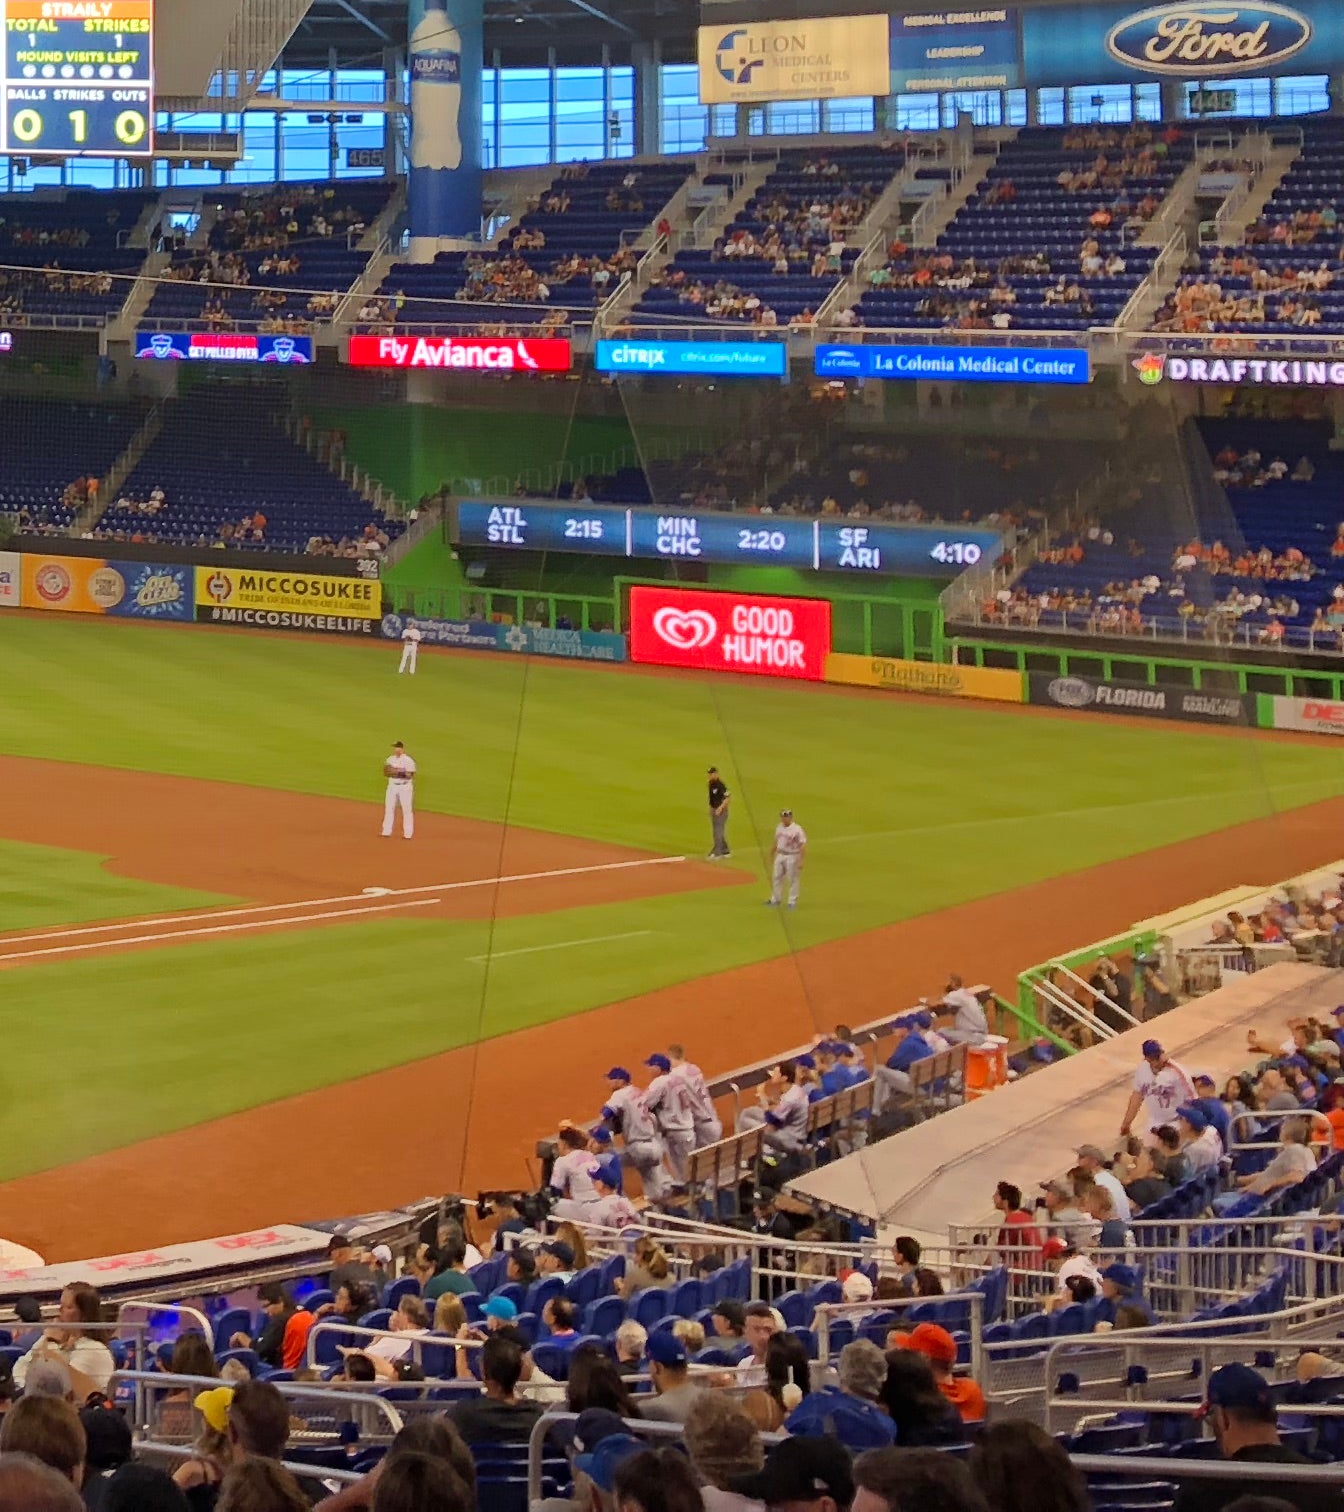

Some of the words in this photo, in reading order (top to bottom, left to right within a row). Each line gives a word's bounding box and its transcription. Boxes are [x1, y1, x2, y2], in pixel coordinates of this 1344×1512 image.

[42, 2, 112, 16] STRAILY
[6, 18, 58, 32] TOTAL
[84, 19, 150, 32] STRIKES
[748, 34, 806, 54] LEON
[1145, 11, 1270, 62] Ford
[16, 51, 63, 62] MOUND
[65, 51, 104, 63] VISITS
[107, 51, 139, 63] LEFT
[414, 59, 457, 73] AQUAFINA
[772, 54, 832, 68] MEDICAL
[791, 70, 851, 84] CENTERS
[7, 89, 46, 100] BALLS
[53, 90, 105, 101] STRIKES
[112, 90, 147, 101] OUTS
[13, 109, 42, 142] 0
[69, 110, 86, 143] 1
[115, 110, 145, 144] 0
[349, 149, 384, 166] 465
[379, 339, 408, 364] Fly
[411, 338, 514, 367] Avianca
[876, 354, 892, 370] La
[896, 355, 954, 372] Colonia
[958, 357, 1018, 374] Medical
[1022, 358, 1076, 375] Center
[488, 507, 528, 527] ATL
[657, 517, 696, 536] MIN
[488, 525, 524, 544] STL
[565, 519, 603, 538] 2:15
[839, 528, 869, 547] SF
[656, 537, 702, 556] CHC
[737, 530, 785, 551] 2:20
[839, 547, 880, 569] ARI
[930, 542, 982, 565] 4:10
[239, 576, 372, 601] MICCOSUKEE
[212, 607, 372, 634] #MICCOSUKEELIFE
[733, 606, 793, 637] GOOD
[532, 641, 613, 658] HEALTHCARE
[723, 635, 805, 668] HUMOR
[1096, 686, 1165, 709] FLORIDA
